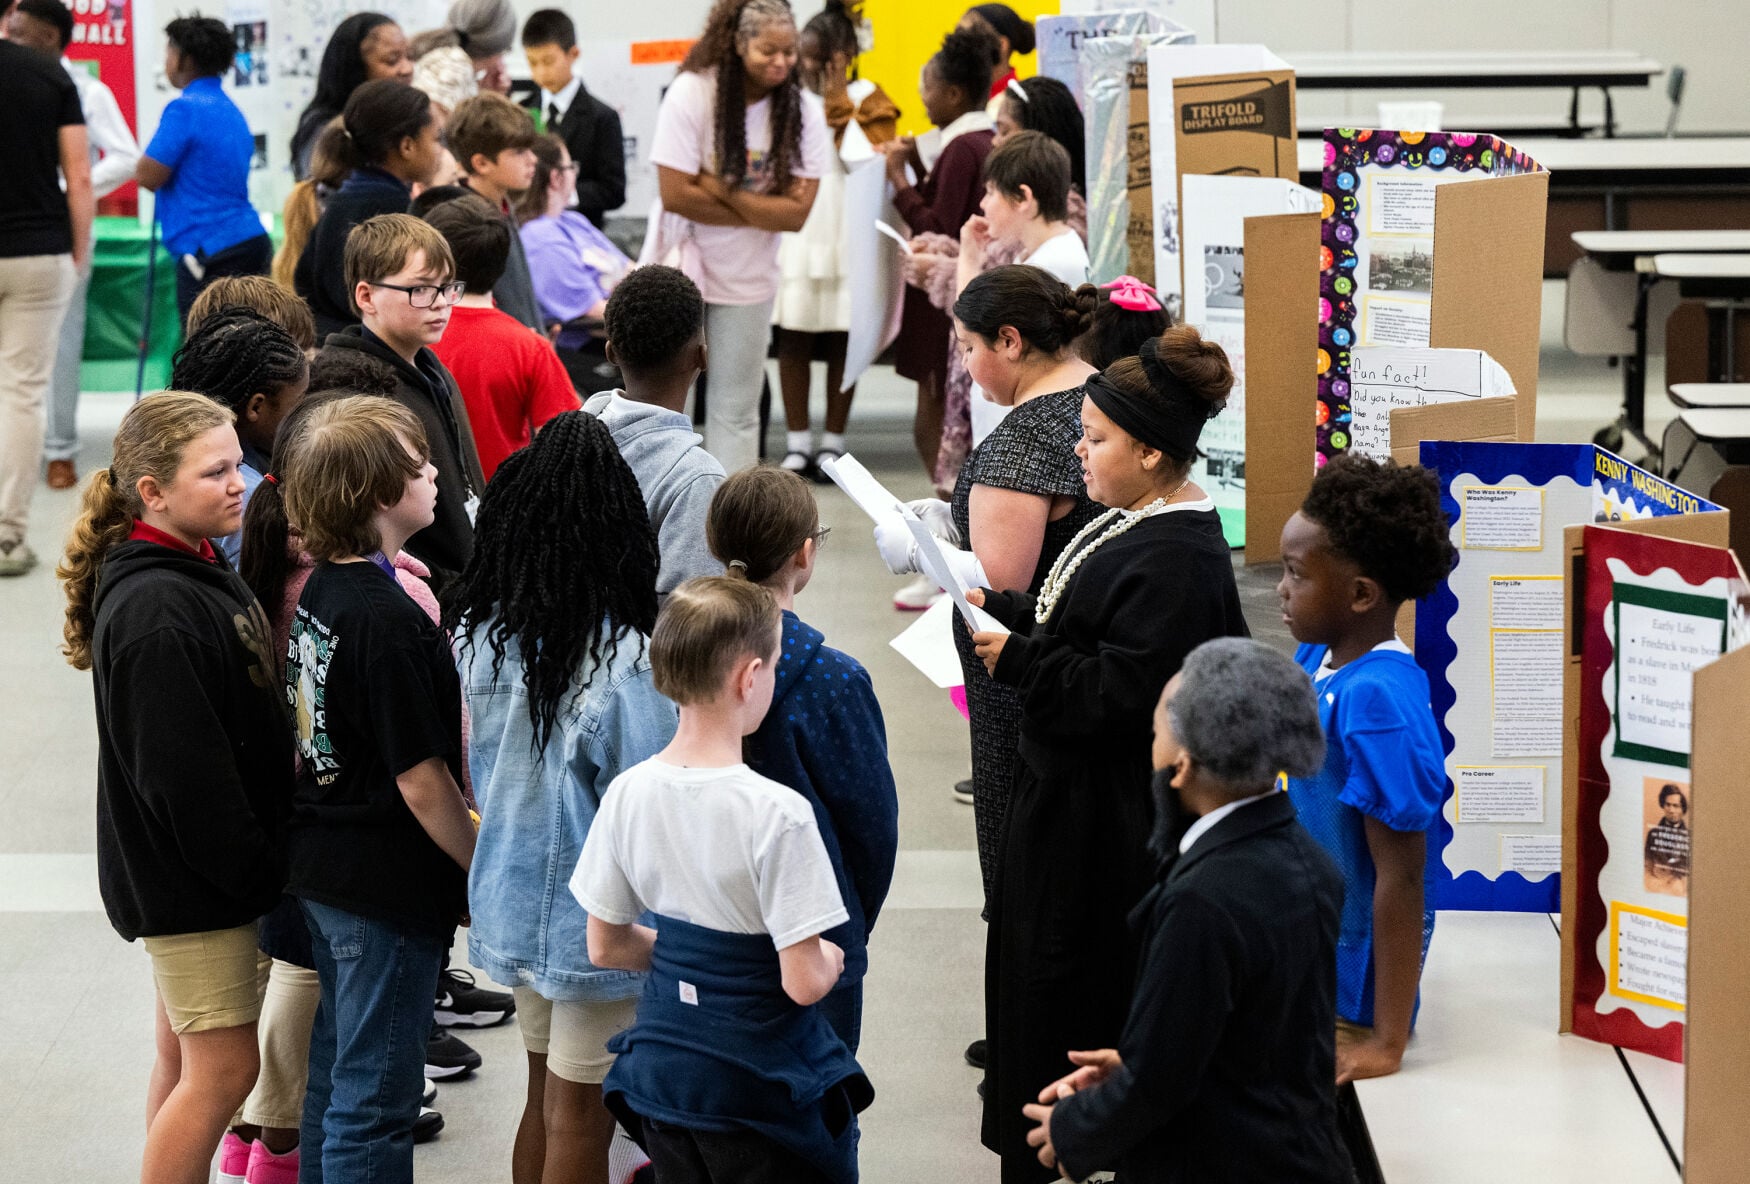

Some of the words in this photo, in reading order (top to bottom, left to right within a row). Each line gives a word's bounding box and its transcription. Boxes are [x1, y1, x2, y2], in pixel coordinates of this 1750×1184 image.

[1191, 102, 1256, 119] TRIFOLD
[1184, 118, 1227, 130] DISPLAY
[1228, 114, 1264, 126] BOARD
[1382, 364, 1427, 384] fact!
[1354, 388, 1367, 402] Did
[1370, 393, 1386, 405] you
[1390, 392, 1411, 406] know
[1416, 393, 1438, 406] th
[1373, 422, 1389, 436] Ange
[1595, 452, 1629, 484] KENNY
[1651, 618, 1675, 634] Early
[1677, 621, 1696, 635] Life
[1640, 636, 1677, 652] Fredrick
[1679, 645, 1698, 655] was
[1627, 657, 1637, 666] as
[1645, 656, 1667, 670] slave
[1669, 660, 1679, 671] in
[1627, 673, 1637, 684] in
[1640, 693, 1654, 706] He
[1656, 695, 1686, 712] taught
[1627, 711, 1637, 722] to
[1638, 712, 1657, 726] read
[1658, 715, 1676, 729] and
[1630, 913, 1653, 929] Major
[1655, 920, 1688, 937] Achieve
[1626, 930, 1658, 947] Escaped
[1626, 946, 1657, 962] Became
[1626, 961, 1651, 977] Wrote
[1652, 968, 1686, 986] newspap
[1626, 977, 1655, 993] Fought
[1656, 984, 1668, 995] for
